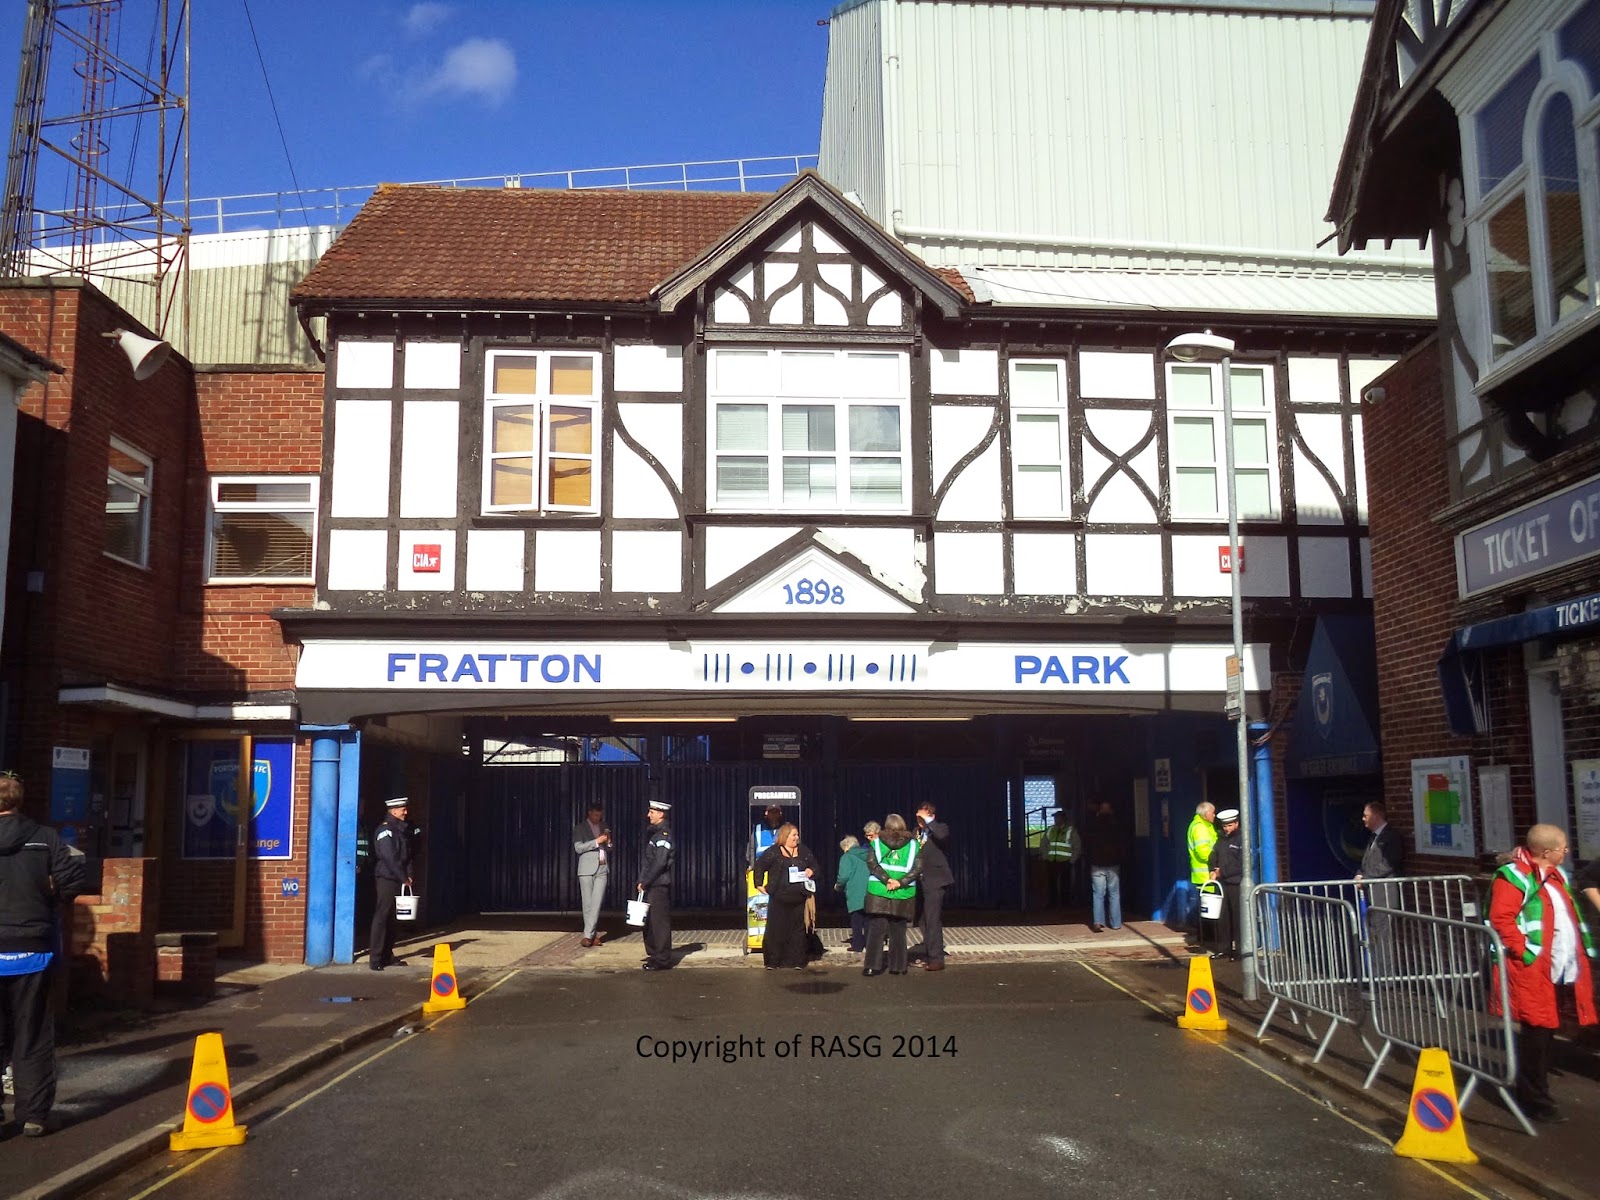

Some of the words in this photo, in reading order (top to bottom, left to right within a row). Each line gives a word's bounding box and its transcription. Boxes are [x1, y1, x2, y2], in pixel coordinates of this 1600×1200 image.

[1483, 513, 1550, 575] TICKET
[413, 553, 429, 567] CIA
[783, 577, 845, 605] 1898
[1556, 596, 1600, 628] TICKE
[387, 652, 602, 683] FRATTON
[1014, 655, 1131, 684] PARK
[258, 764, 268, 774] FC
[753, 791, 797, 800] PROGRAMMES
